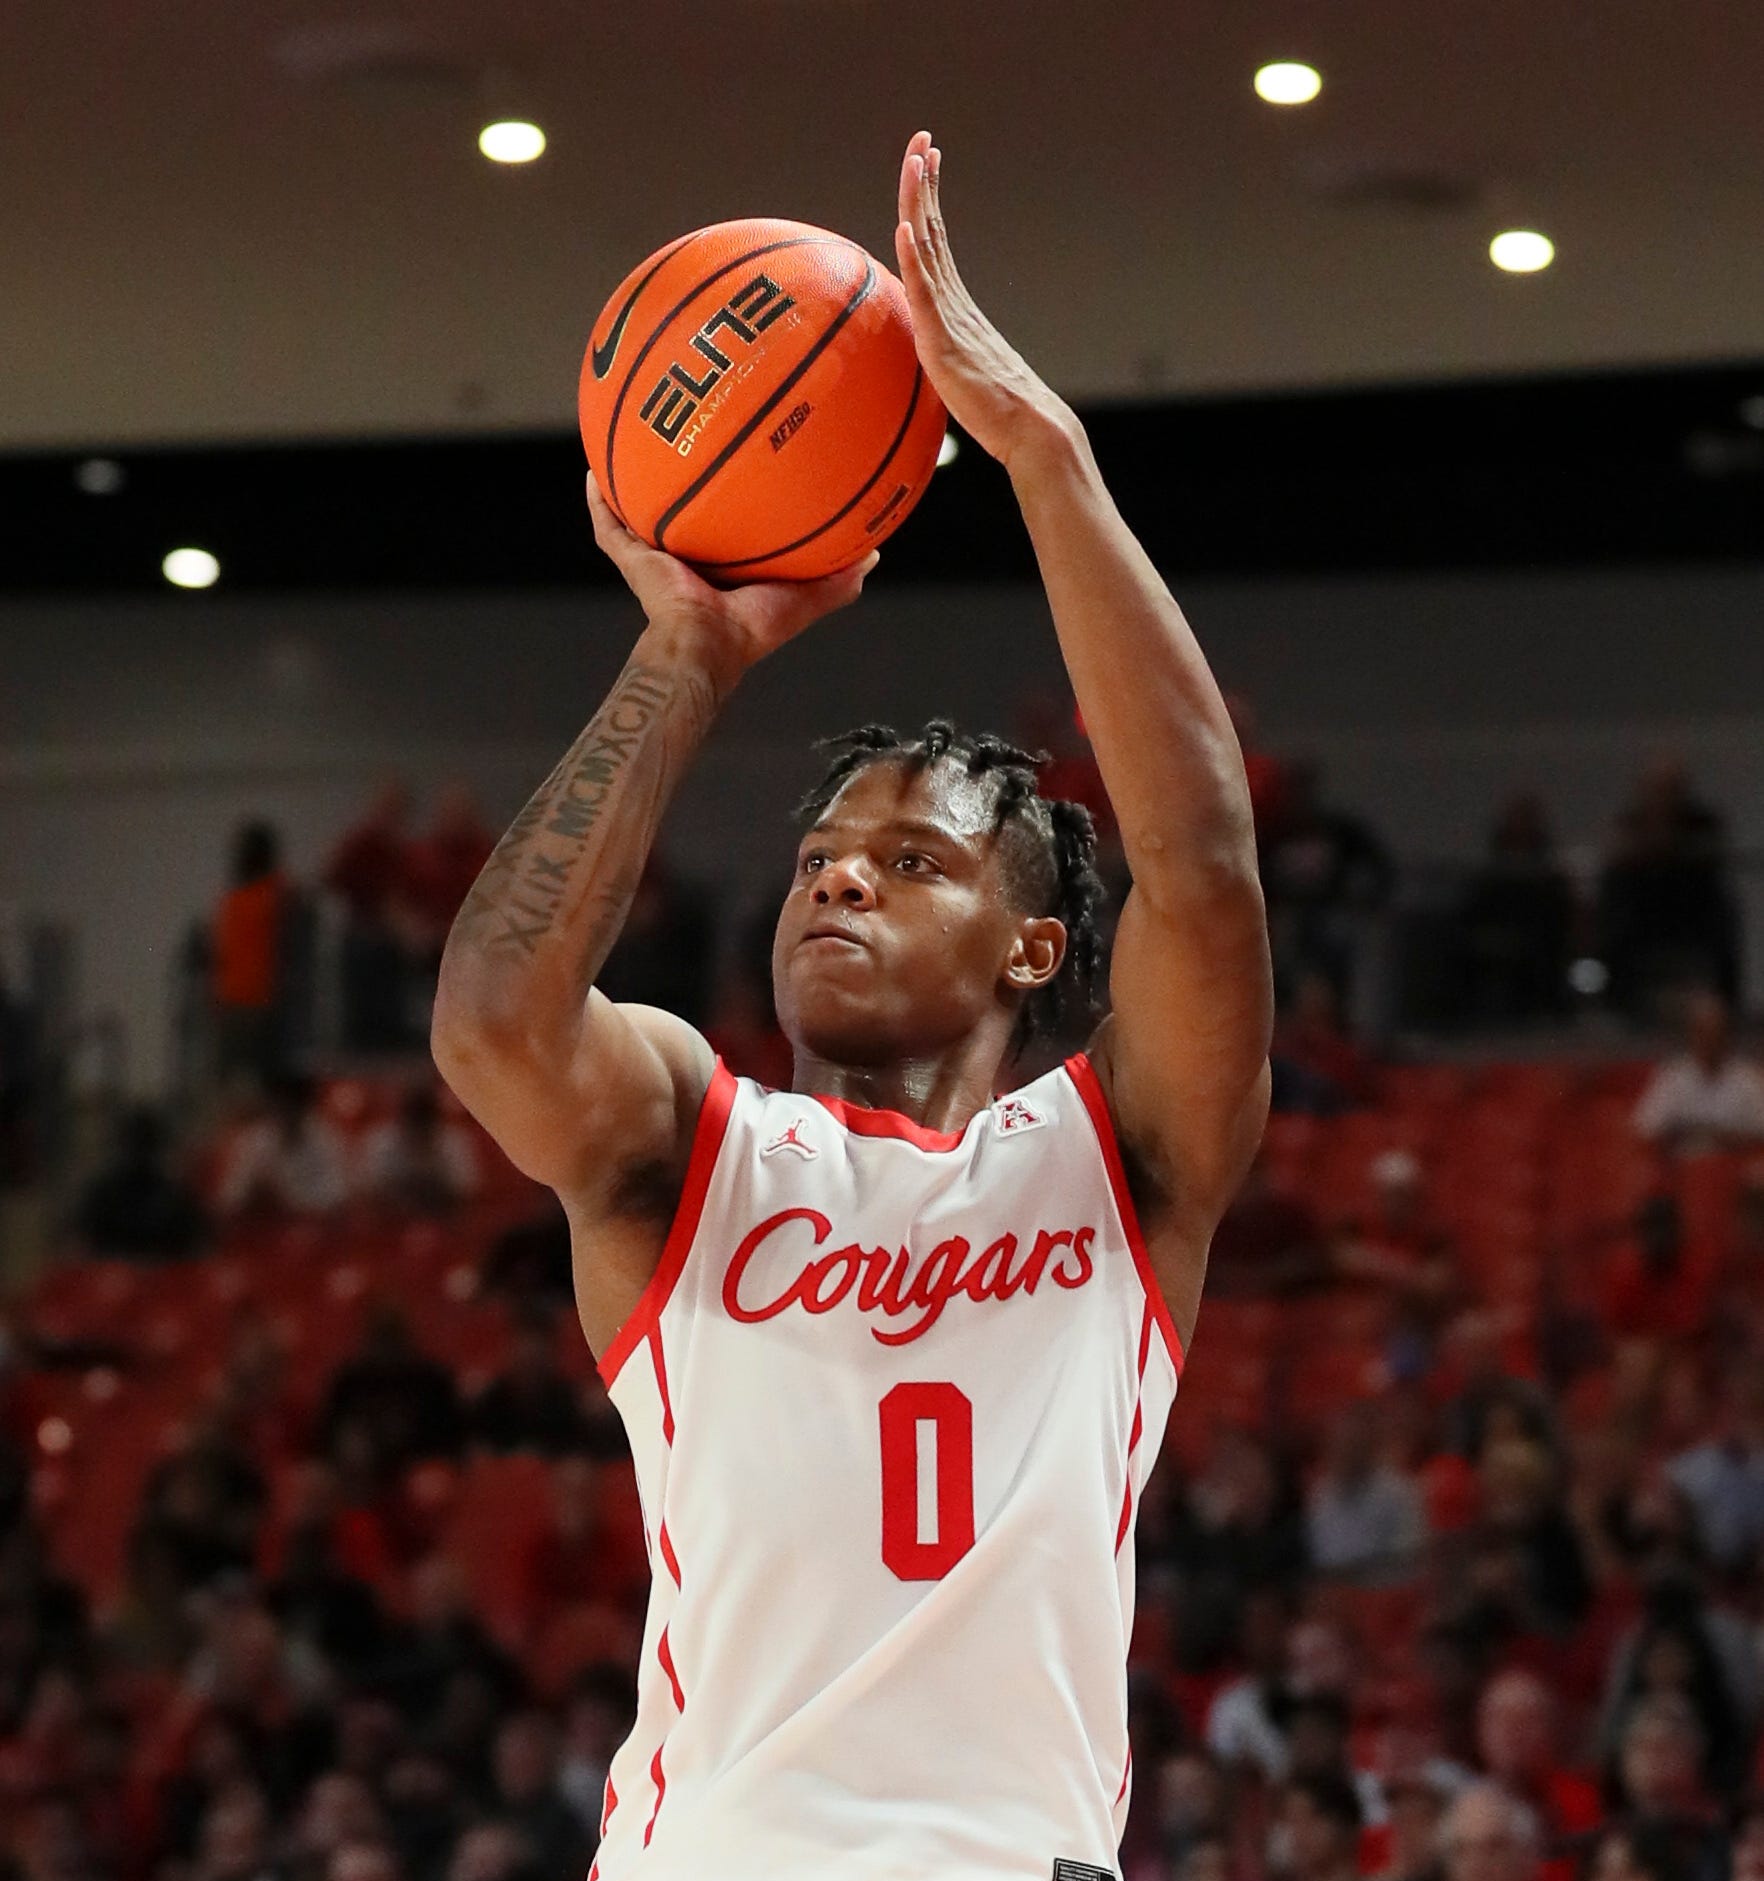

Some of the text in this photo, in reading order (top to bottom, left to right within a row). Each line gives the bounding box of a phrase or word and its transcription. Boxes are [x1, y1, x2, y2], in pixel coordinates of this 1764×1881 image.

[638, 272, 797, 446] ELITE
[721, 1206, 1095, 1346] Cougars
[878, 1382, 976, 1581] 0
